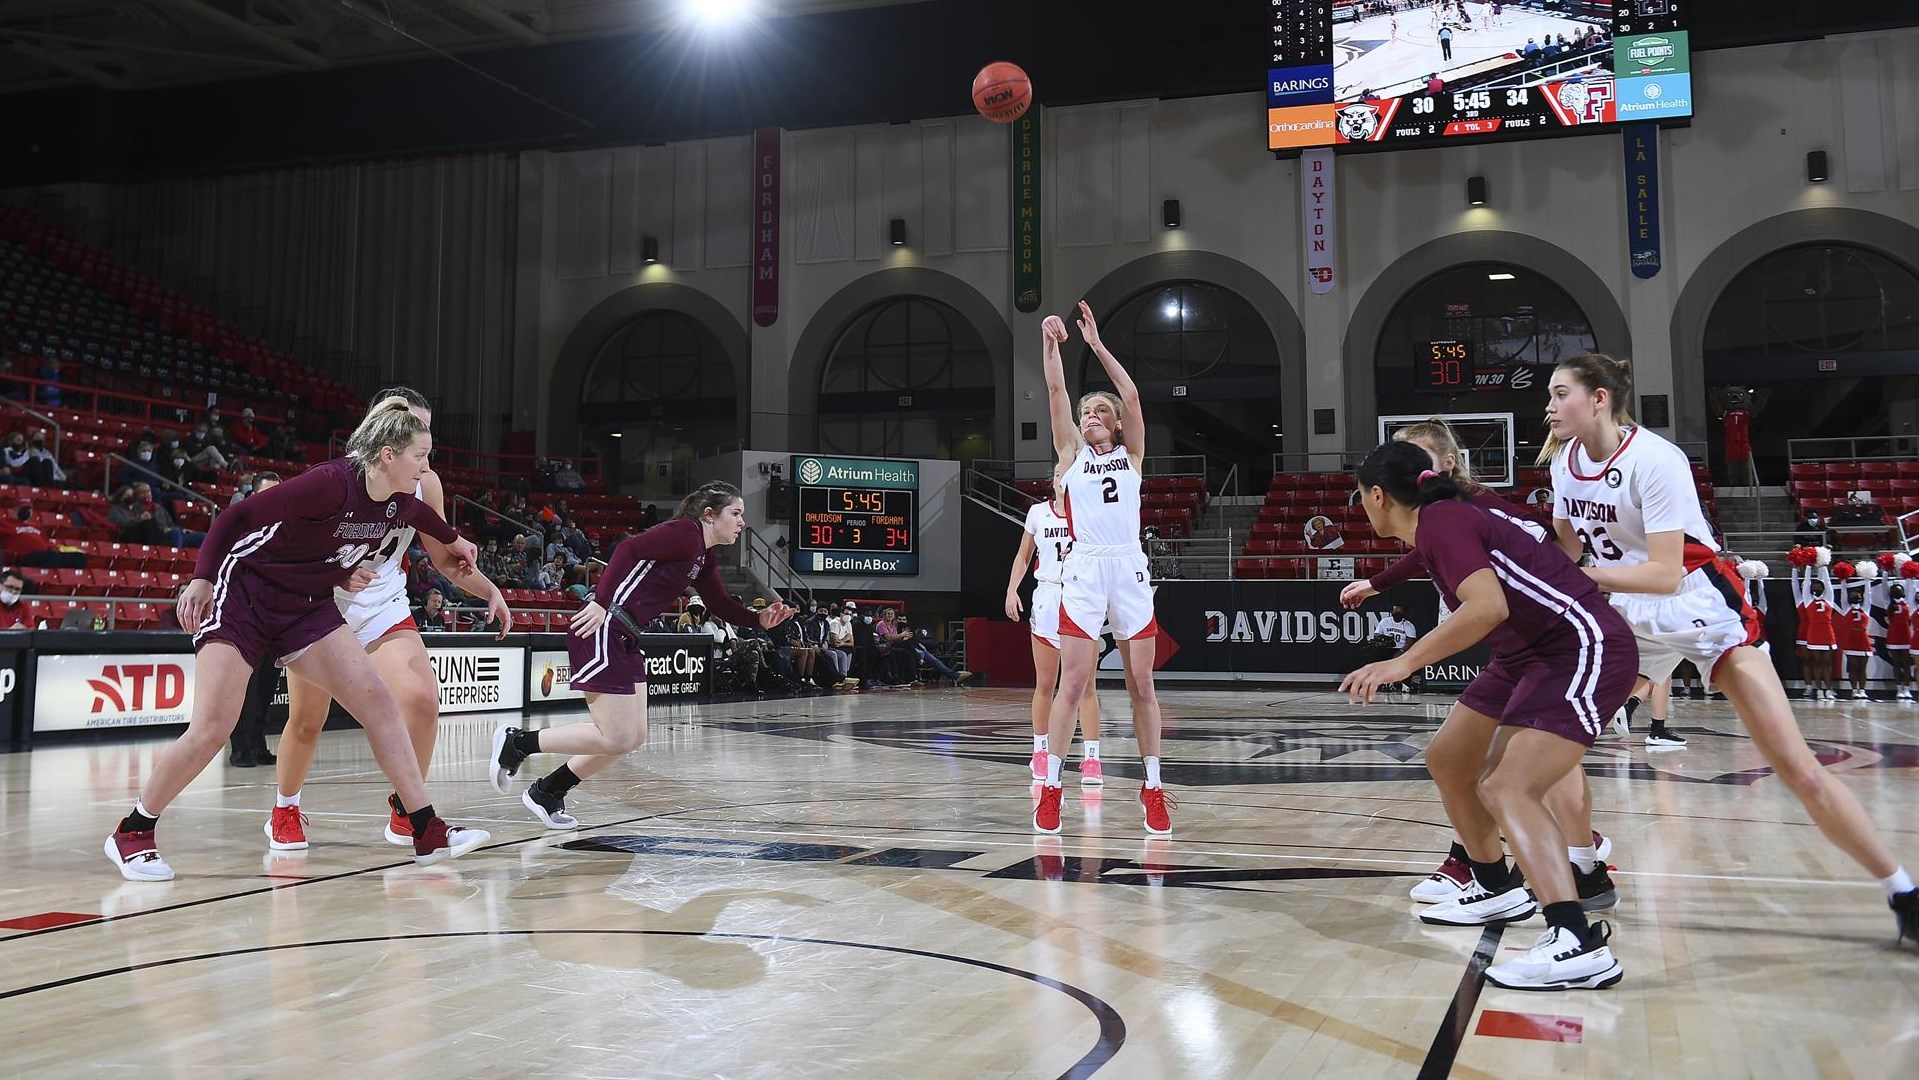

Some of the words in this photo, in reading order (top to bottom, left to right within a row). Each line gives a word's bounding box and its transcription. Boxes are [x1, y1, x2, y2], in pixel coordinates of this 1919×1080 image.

[1618, 9, 1630, 17] 20
[1647, 6, 1654, 14] 5
[1670, 4, 1677, 12] 0
[1619, 24, 1630, 32] 30
[1648, 22, 1654, 30] 2
[1300, 51, 1305, 59] 7
[1630, 47, 1647, 58] FUEL
[1648, 45, 1673, 57] POINTS
[1273, 77, 1329, 92] BARINGS
[1412, 97, 1434, 114] 30
[1453, 91, 1490, 111] 5:45
[1506, 89, 1528, 106] 34
[1620, 102, 1656, 112] Atrium
[1656, 99, 1688, 109] Health
[1453, 124, 1459, 132] 4
[1464, 123, 1481, 132] TOL
[1486, 121, 1493, 129] 3
[1505, 119, 1531, 128] FOULS
[1539, 115, 1546, 125] 2
[1395, 128, 1421, 137] FOULS
[1428, 124, 1435, 134] 2
[1636, 138, 1646, 161] LA
[1022, 120, 1031, 199] GEORGE
[1312, 160, 1325, 252] DAYTON
[1637, 175, 1649, 239] SALLE
[759, 155, 774, 280] FORDHAM
[1021, 207, 1032, 273] MASON
[1431, 345, 1466, 360] 5:45
[1430, 360, 1461, 385] 30
[1488, 373, 1505, 385] 30
[828, 466, 873, 481] Atrium
[874, 468, 915, 482] Health
[1101, 476, 1119, 503] 2
[843, 491, 881, 511] 5:45
[805, 512, 842, 524] DAVIDSON
[846, 519, 867, 527] PERIOD
[871, 515, 904, 525] FORDHAM
[811, 525, 833, 545] 30
[853, 528, 861, 544] 3
[886, 527, 907, 547] 34
[825, 557, 897, 571] BedInABox
[1328, 559, 1340, 570] E
[1205, 611, 1391, 643] DAVIDSON
[640, 649, 672, 675] reat
[674, 649, 704, 681] Clips
[1425, 665, 1480, 681] BARIN
[86, 664, 185, 713] ATD
[649, 684, 671, 695] GONNA
[671, 683, 680, 694] BE
[681, 682, 699, 694] GREAT
[86, 718, 120, 727] AMERICAN
[122, 716, 137, 725] TIRE
[139, 713, 184, 724] DISTRIBUTORS
